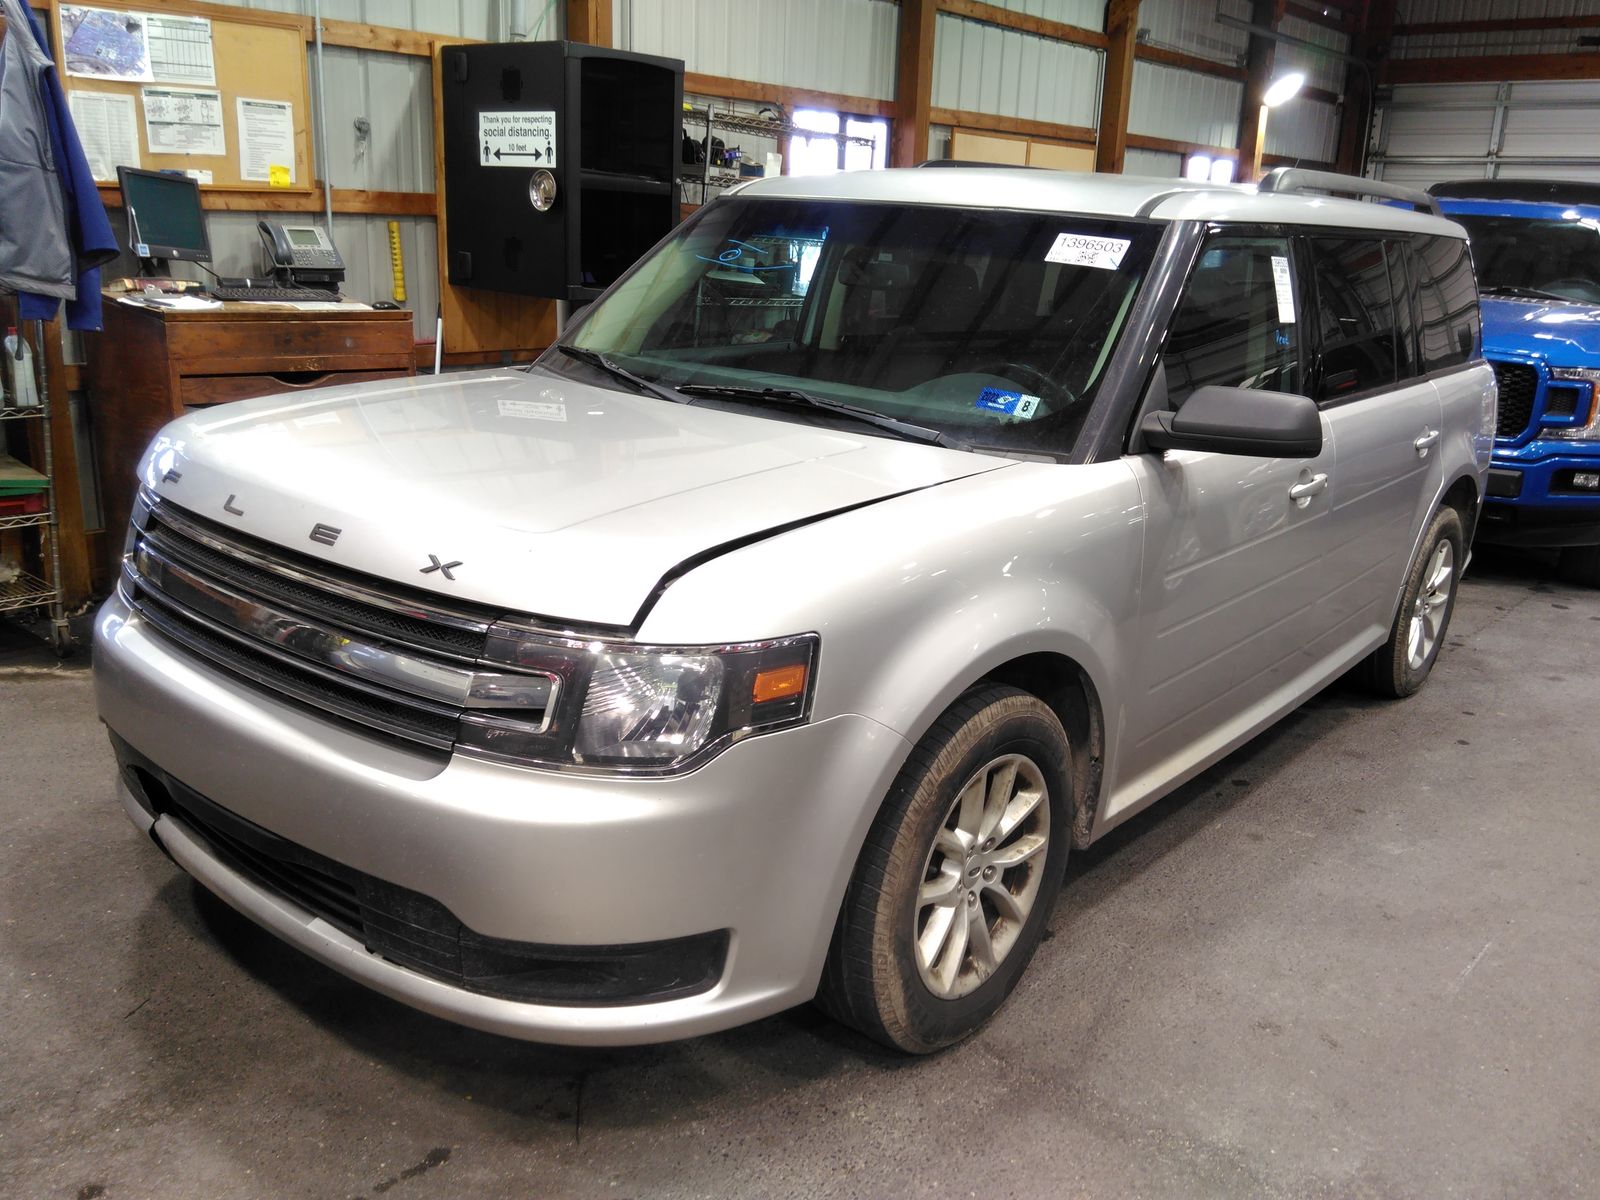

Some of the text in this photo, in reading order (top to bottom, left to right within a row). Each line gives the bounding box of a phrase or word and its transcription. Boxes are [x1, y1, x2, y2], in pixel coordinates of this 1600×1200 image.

[483, 116, 499, 124] Thank
[501, 117, 511, 125] you
[521, 115, 552, 125] respecting
[483, 126, 552, 140] social distancing.
[1061, 237, 1123, 253] 1396503
[1021, 400, 1031, 412] 8
